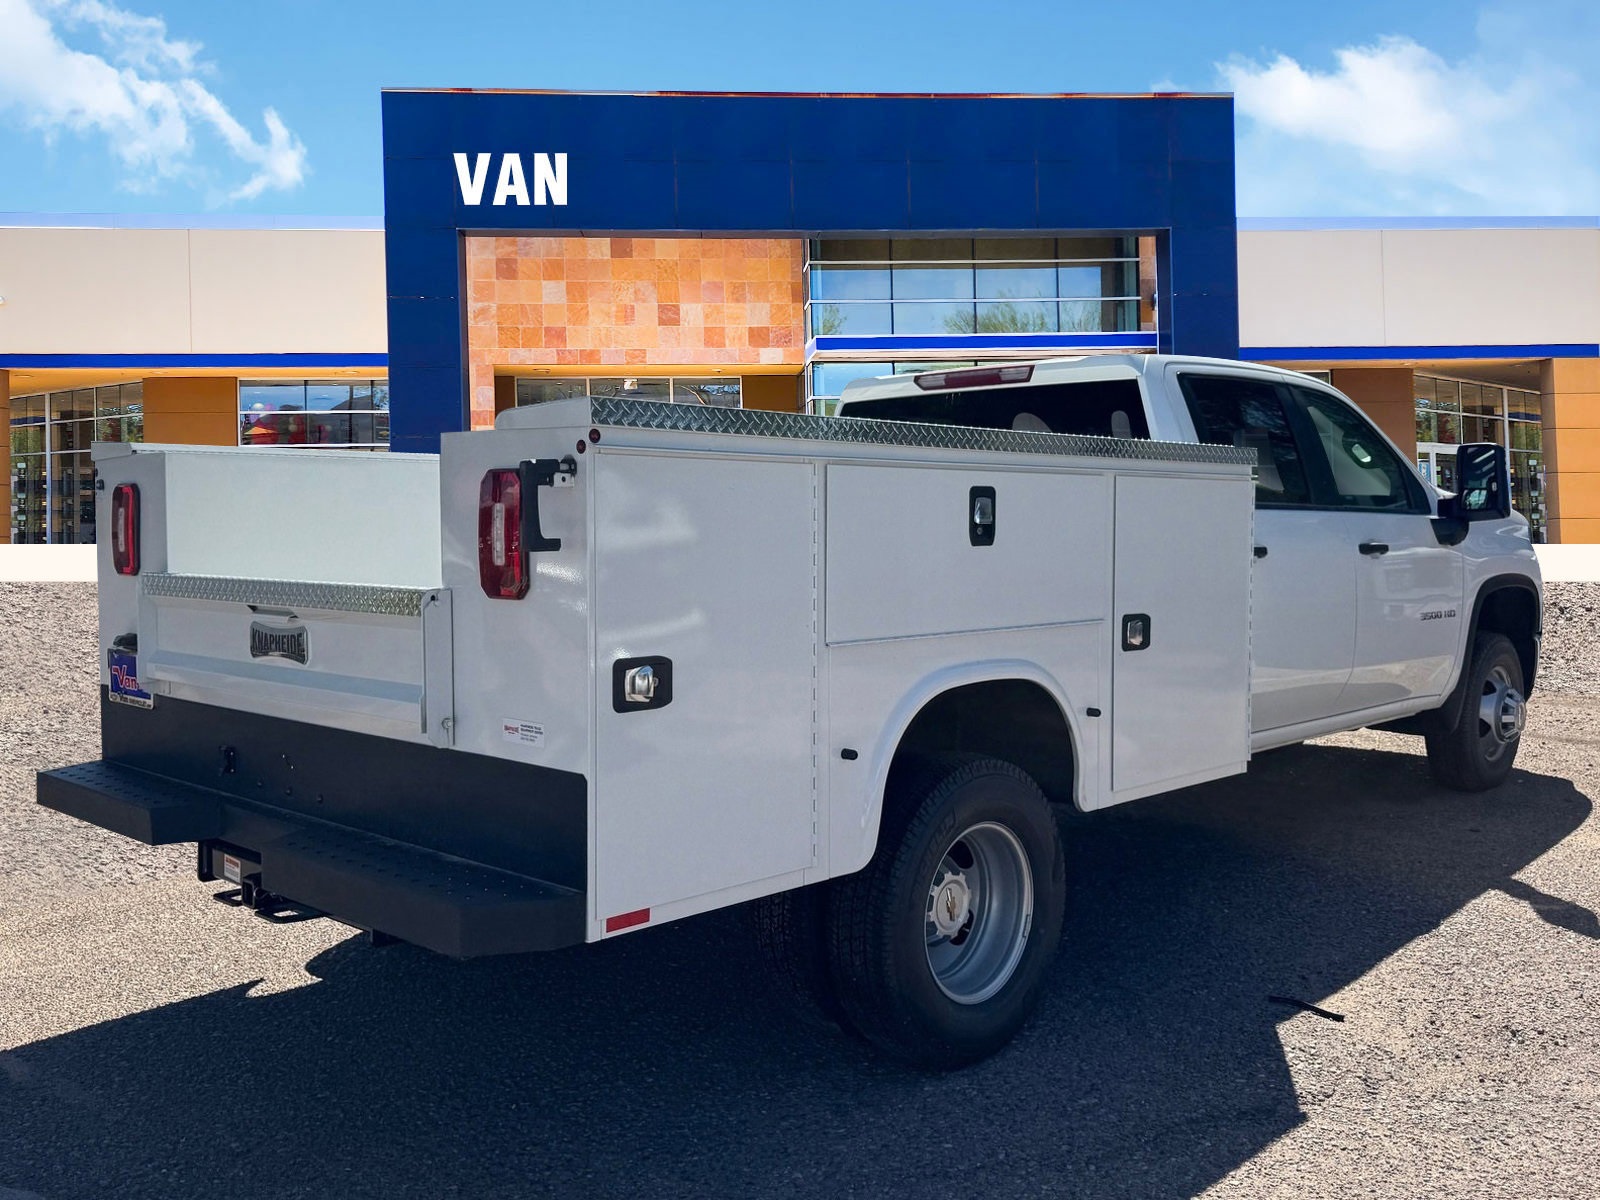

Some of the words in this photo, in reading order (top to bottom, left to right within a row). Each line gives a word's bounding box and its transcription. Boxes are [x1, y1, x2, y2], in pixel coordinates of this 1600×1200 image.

[453, 153, 567, 205] VAN
[1420, 611, 1442, 620] 3500
[251, 627, 305, 656] KNAPHEIDE
